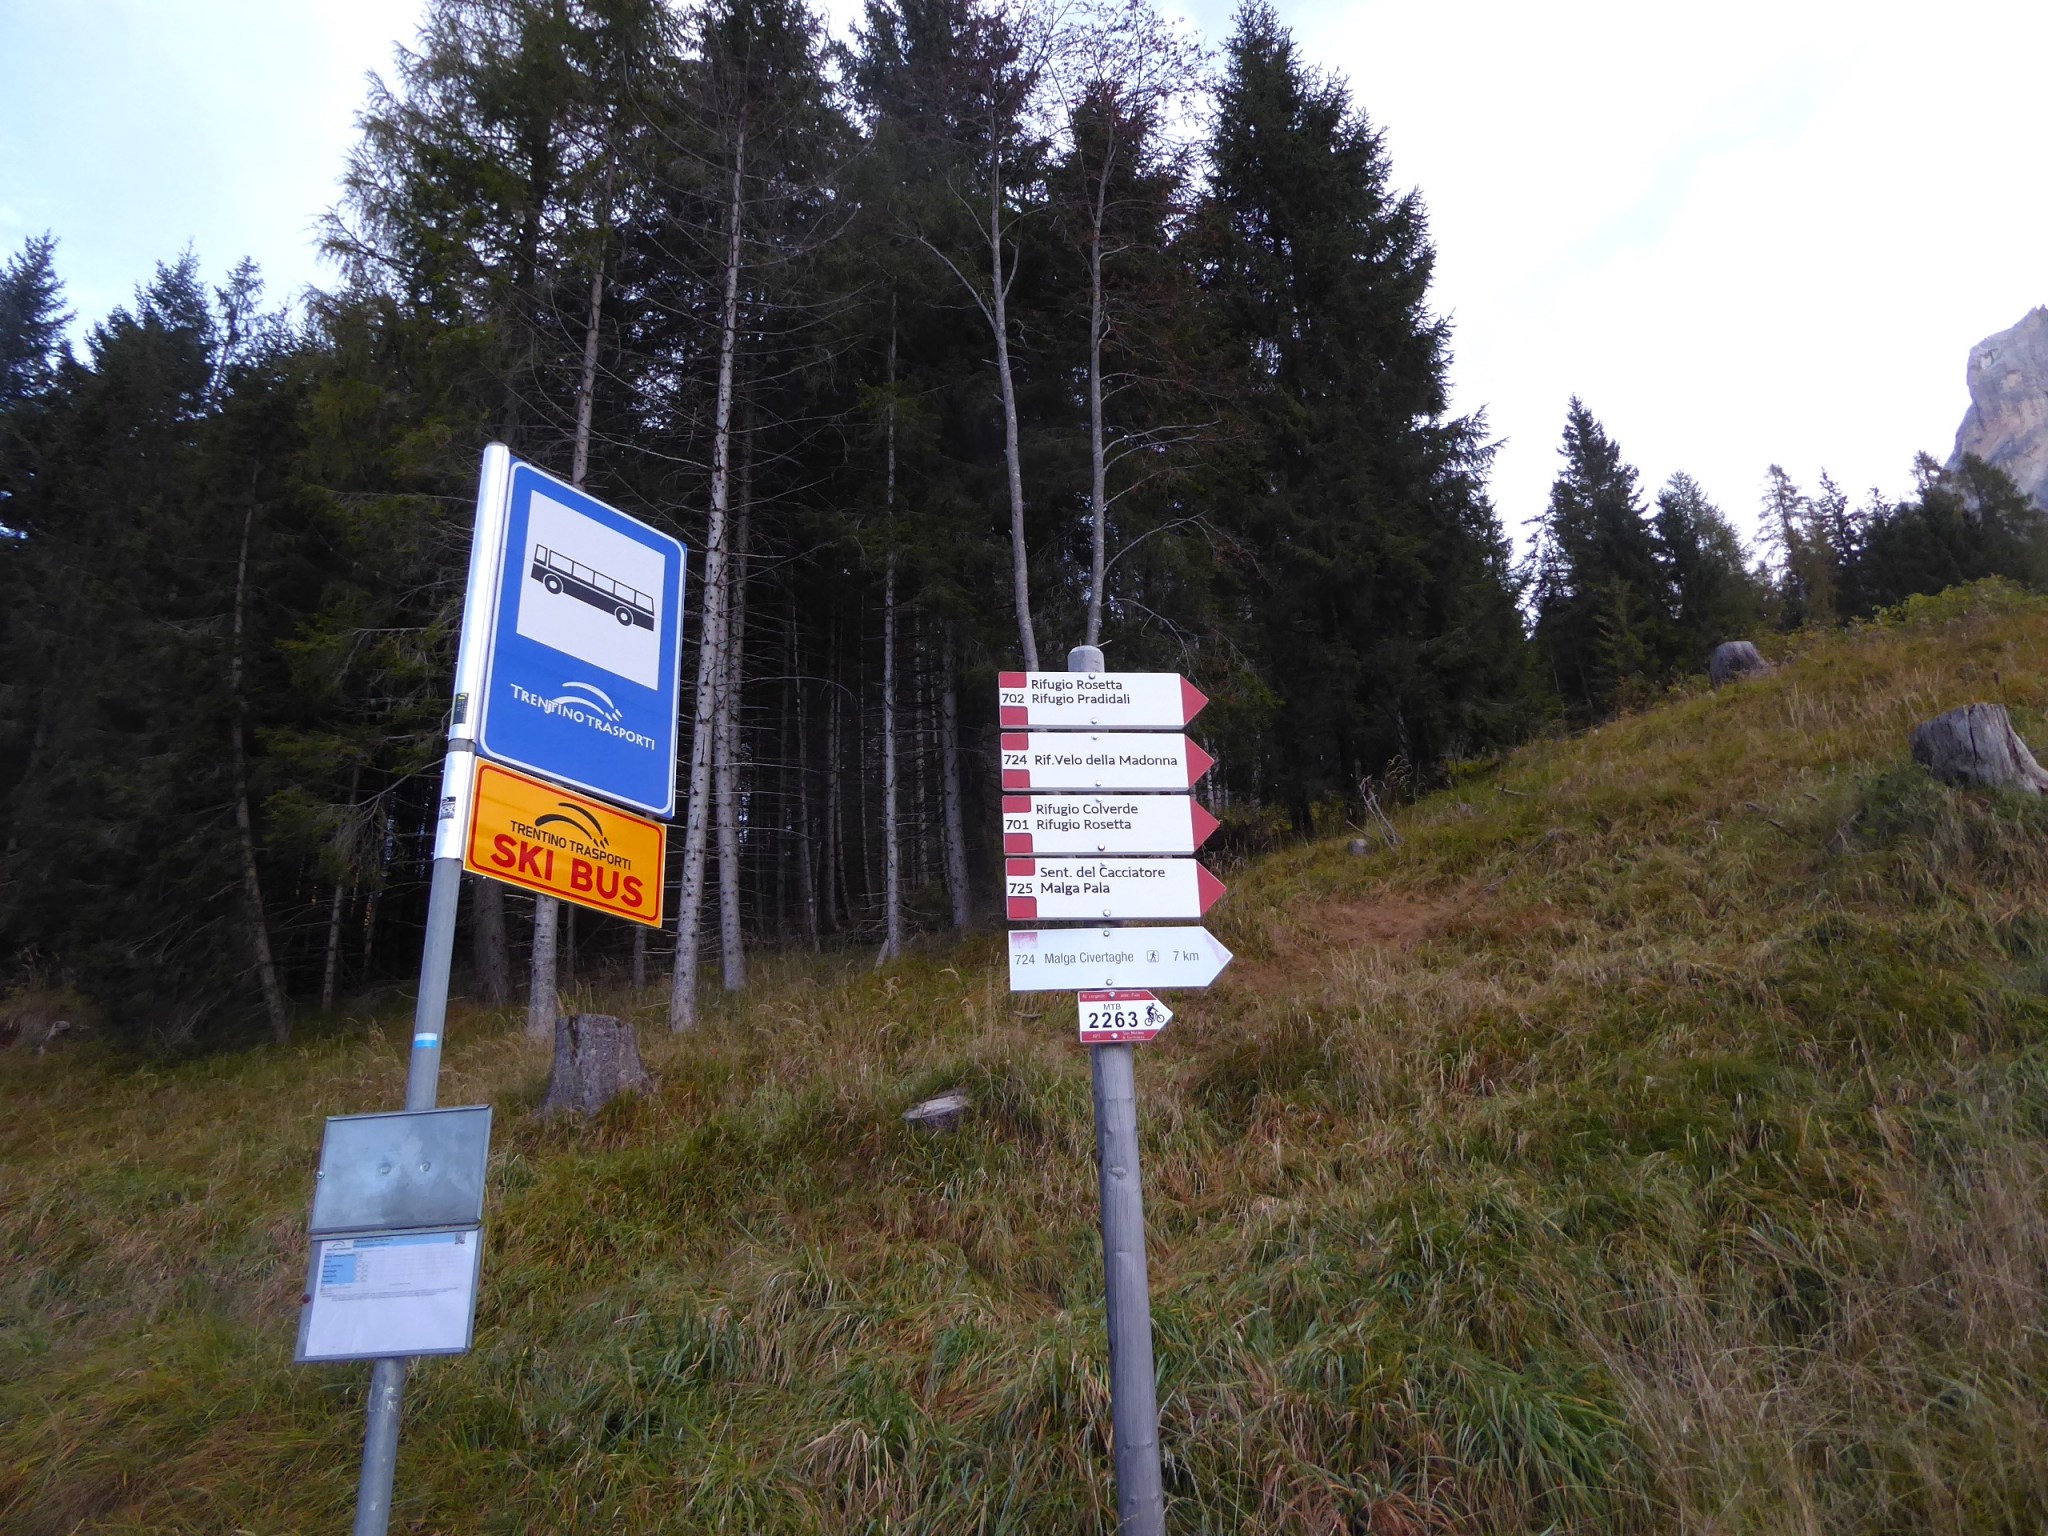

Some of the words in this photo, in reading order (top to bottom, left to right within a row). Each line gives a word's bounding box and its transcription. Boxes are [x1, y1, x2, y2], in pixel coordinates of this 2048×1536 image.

[1031, 679, 1074, 691] Rifugio
[1077, 680, 1122, 690] Rosetta
[1002, 694, 1025, 704] 702
[1032, 693, 1075, 705] Rifugio
[1078, 694, 1130, 704] Pradidali
[510, 683, 585, 722] TRENTINO
[585, 714, 655, 750] TRASPORTI
[1003, 755, 1027, 765] 724
[1086, 755, 1115, 765] della
[1119, 755, 1178, 766] Madonna
[1036, 804, 1080, 816] Rifugio
[1083, 803, 1138, 815] Colverde
[1005, 819, 1029, 830] 701
[1037, 819, 1080, 832] Rifugio
[1084, 819, 1132, 830] Rosetta
[511, 820, 567, 848] TRENTINO
[569, 840, 631, 870] TRASPORTI
[490, 833, 554, 881] SKI
[570, 857, 644, 908] BUS
[1040, 867, 1072, 878] Sent.
[1076, 867, 1096, 878] del
[1099, 867, 1166, 878] Cacciatore
[1009, 883, 1033, 894] 725
[1041, 883, 1079, 895] Malga
[1084, 883, 1110, 893] Pala
[1015, 954, 1035, 965] 724
[1044, 952, 1076, 966] Malga
[1079, 951, 1134, 966] Civertaghe
[1173, 951, 1179, 961] 7
[1183, 951, 1199, 961] km
[1088, 1012, 1138, 1028] 2263
